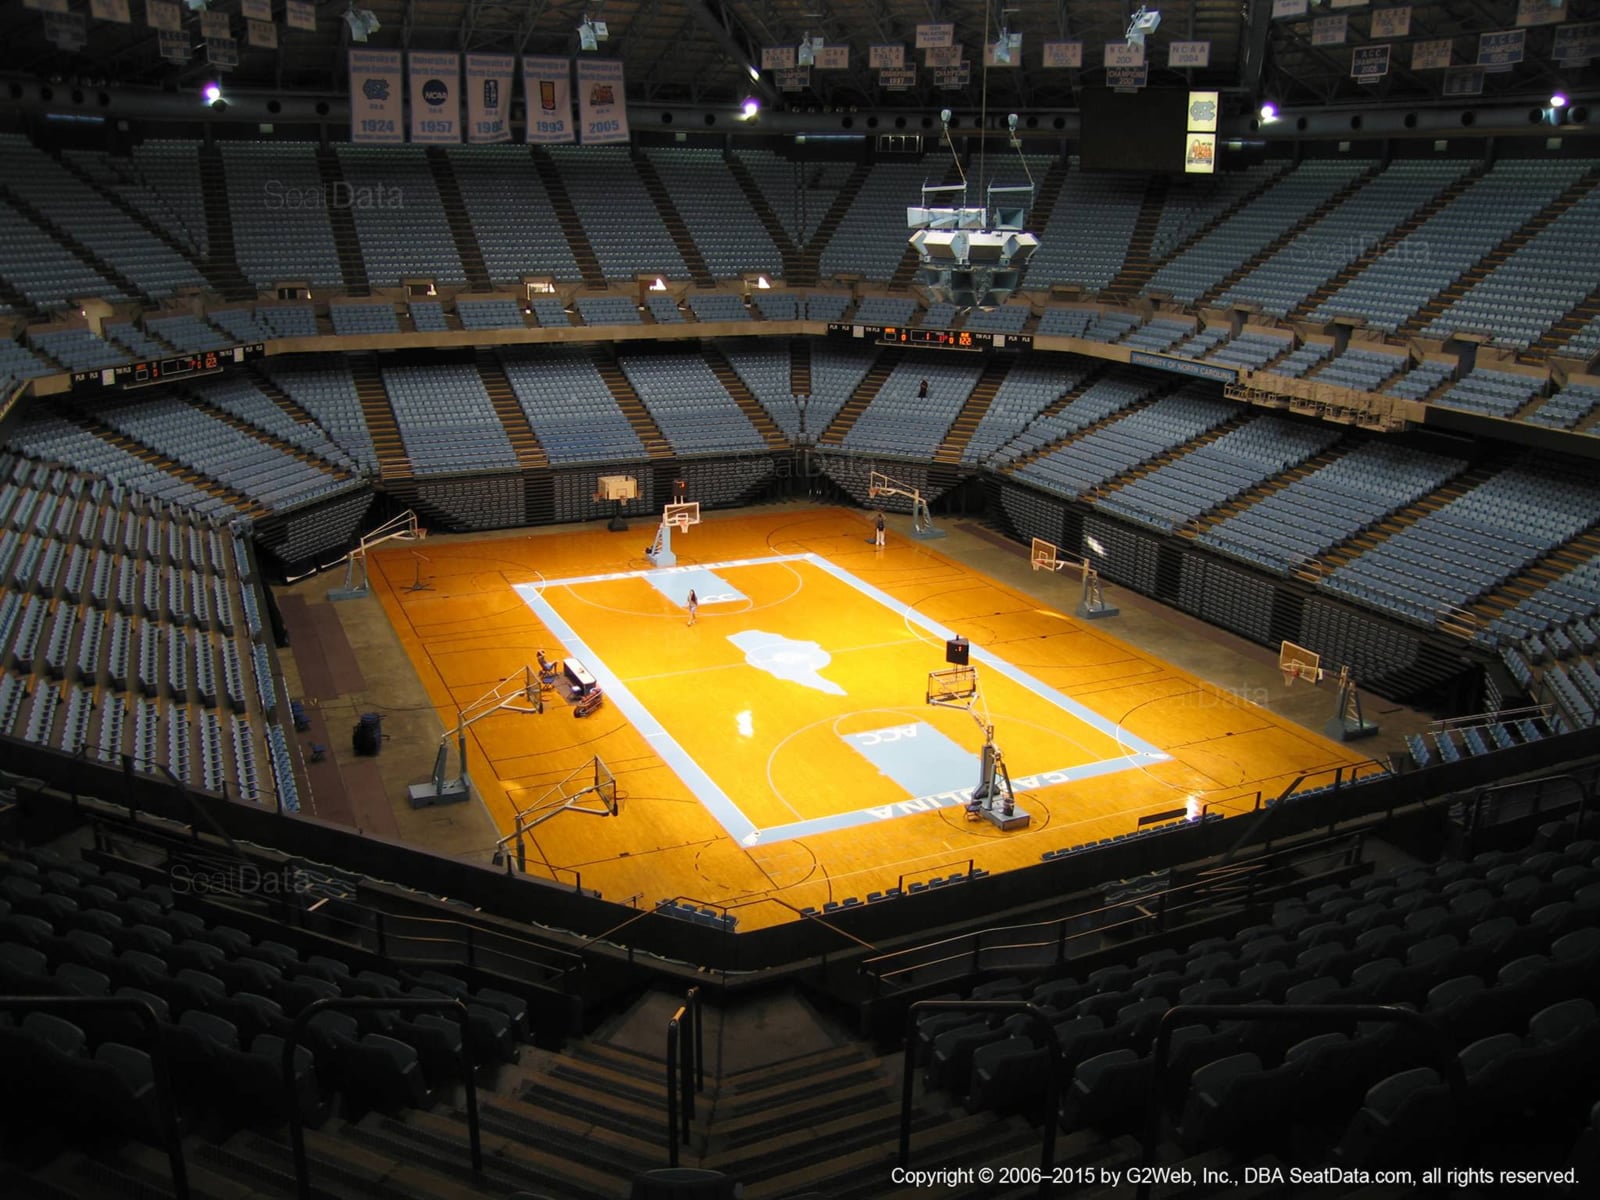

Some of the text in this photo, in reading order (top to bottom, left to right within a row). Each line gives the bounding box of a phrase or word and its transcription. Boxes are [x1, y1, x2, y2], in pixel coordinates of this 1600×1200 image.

[361, 119, 395, 132] 1924
[420, 120, 453, 133] 1957
[536, 120, 564, 132] 1993
[589, 120, 619, 133] 2005
[856, 723, 918, 746] ACC
[865, 771, 1069, 819] CALINA
